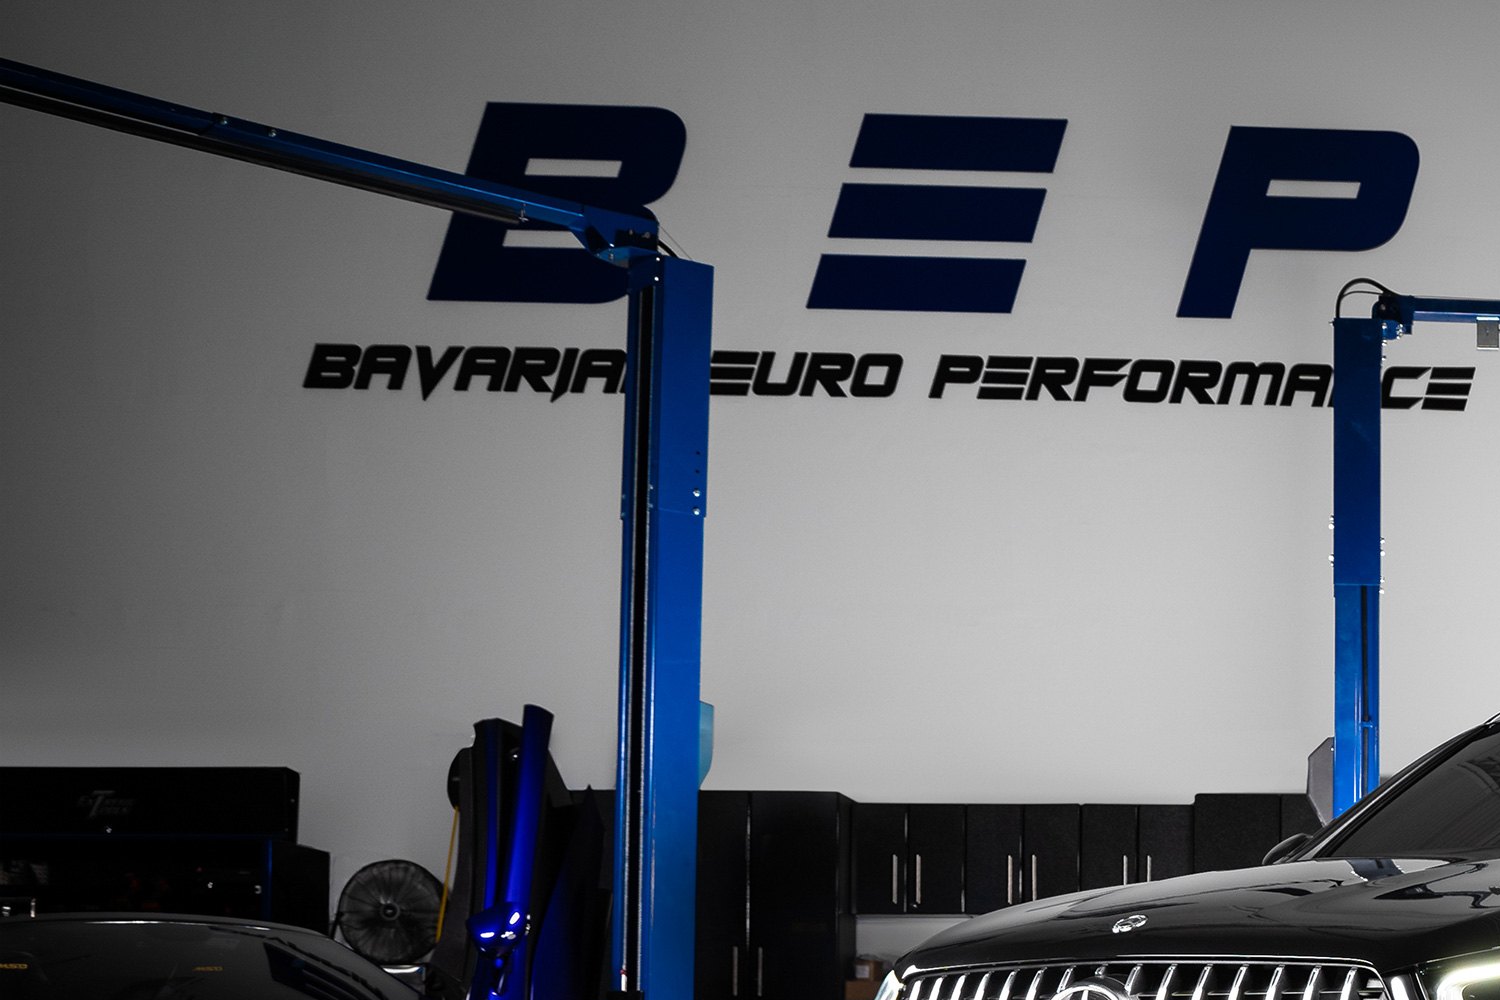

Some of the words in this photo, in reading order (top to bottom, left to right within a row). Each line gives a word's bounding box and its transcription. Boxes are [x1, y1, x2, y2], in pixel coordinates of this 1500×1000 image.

[426, 101, 1421, 319] BEP
[302, 342, 627, 402] BAVARIA
[710, 350, 904, 398] EURO
[928, 354, 1476, 412] PERFORMACE
